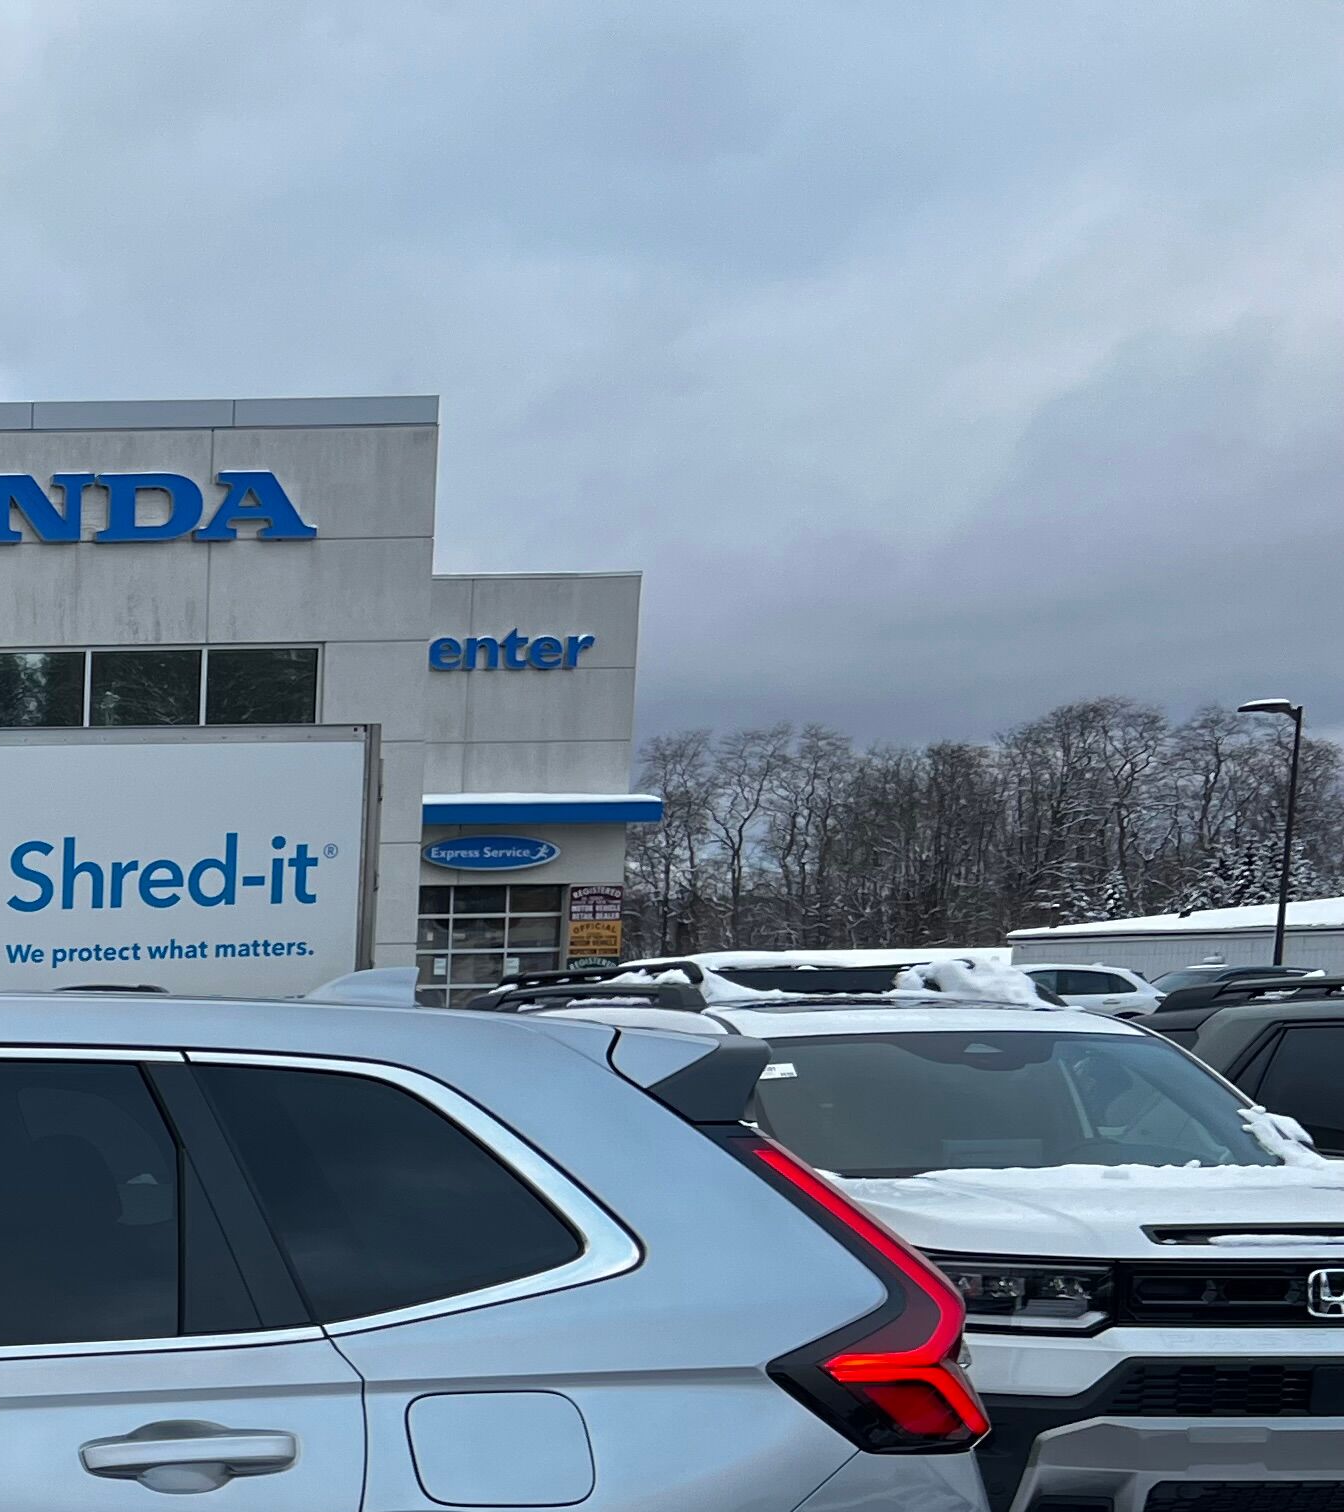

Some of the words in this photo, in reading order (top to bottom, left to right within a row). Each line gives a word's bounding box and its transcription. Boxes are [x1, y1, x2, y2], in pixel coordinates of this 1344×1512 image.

[430, 847, 480, 862] Express
[483, 846, 531, 858] Service
[572, 886, 621, 898] REGISTERED
[573, 922, 616, 934] OFFICIAL
[6, 944, 45, 964] We
[52, 941, 141, 969] protect
[147, 939, 208, 960] what
[215, 939, 315, 960] matters.
